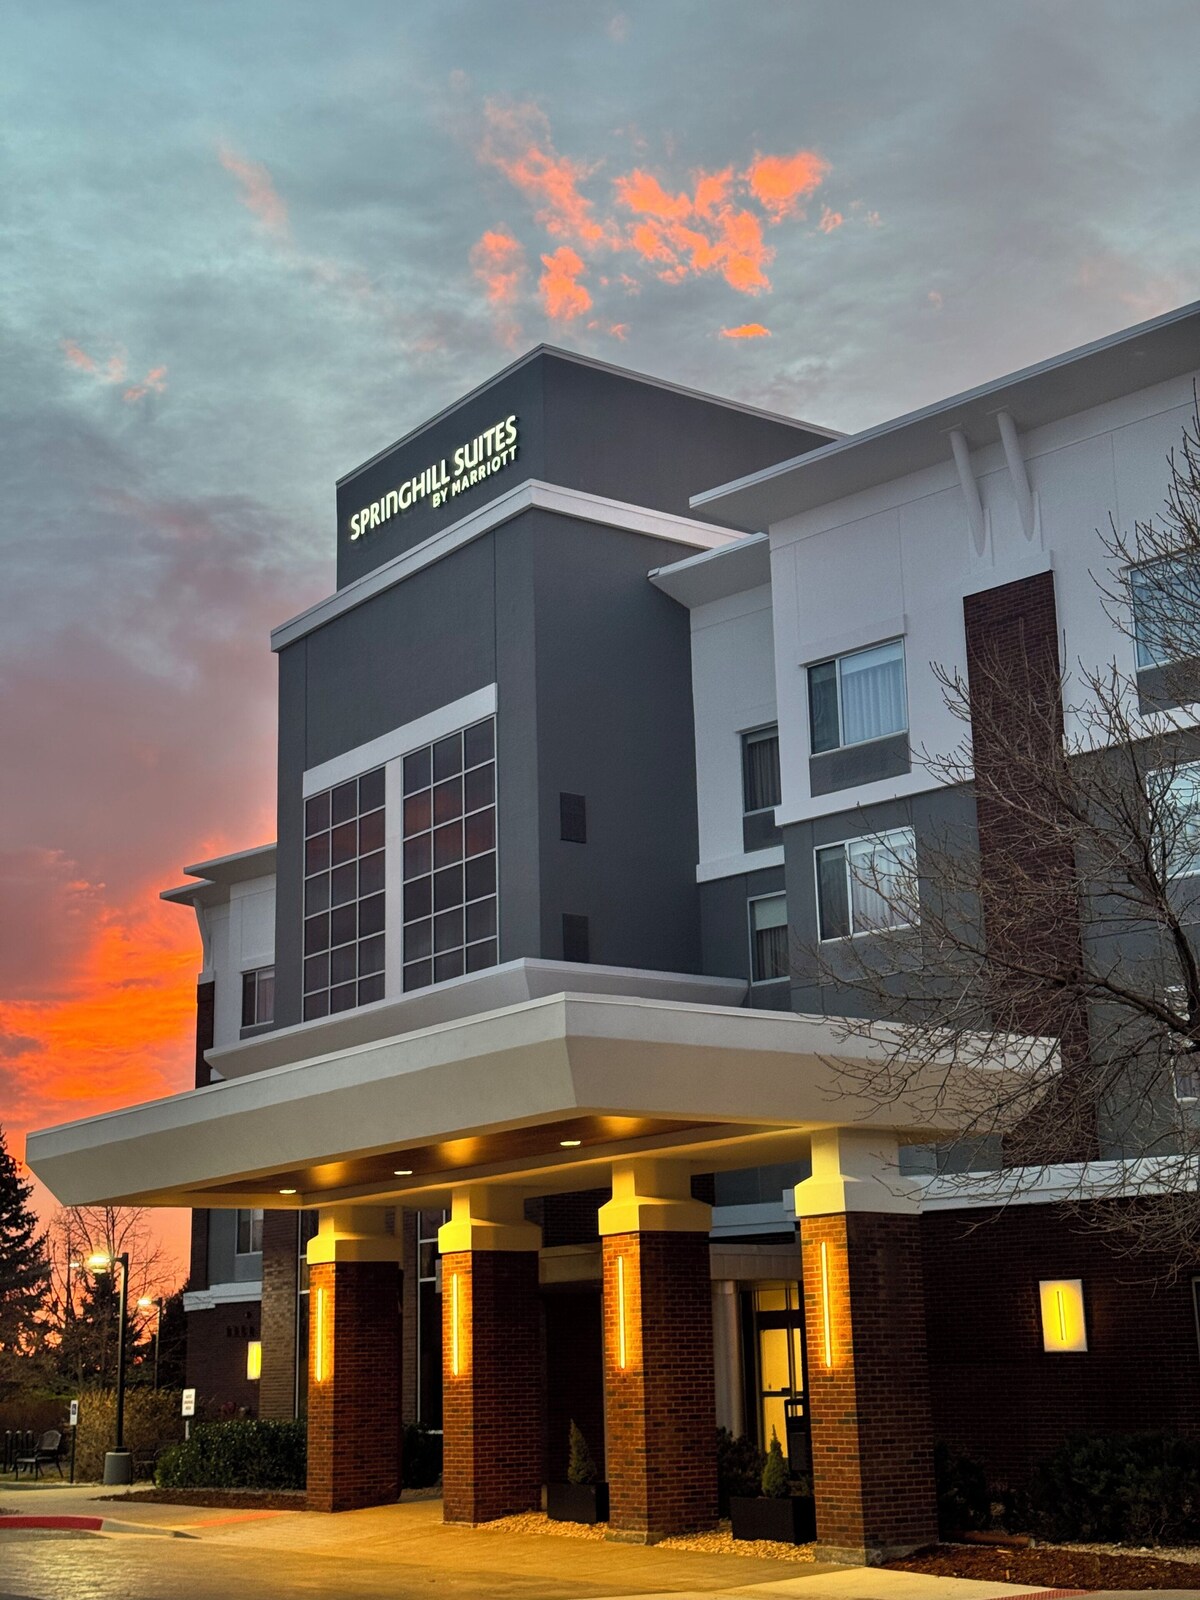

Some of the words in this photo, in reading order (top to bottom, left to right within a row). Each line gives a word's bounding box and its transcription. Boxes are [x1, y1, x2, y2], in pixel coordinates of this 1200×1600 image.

[350, 459, 451, 541] SPRINGHILL
[454, 415, 518, 476] SUITES
[432, 487, 449, 509] BY
[451, 445, 518, 497] MARRIOTT
